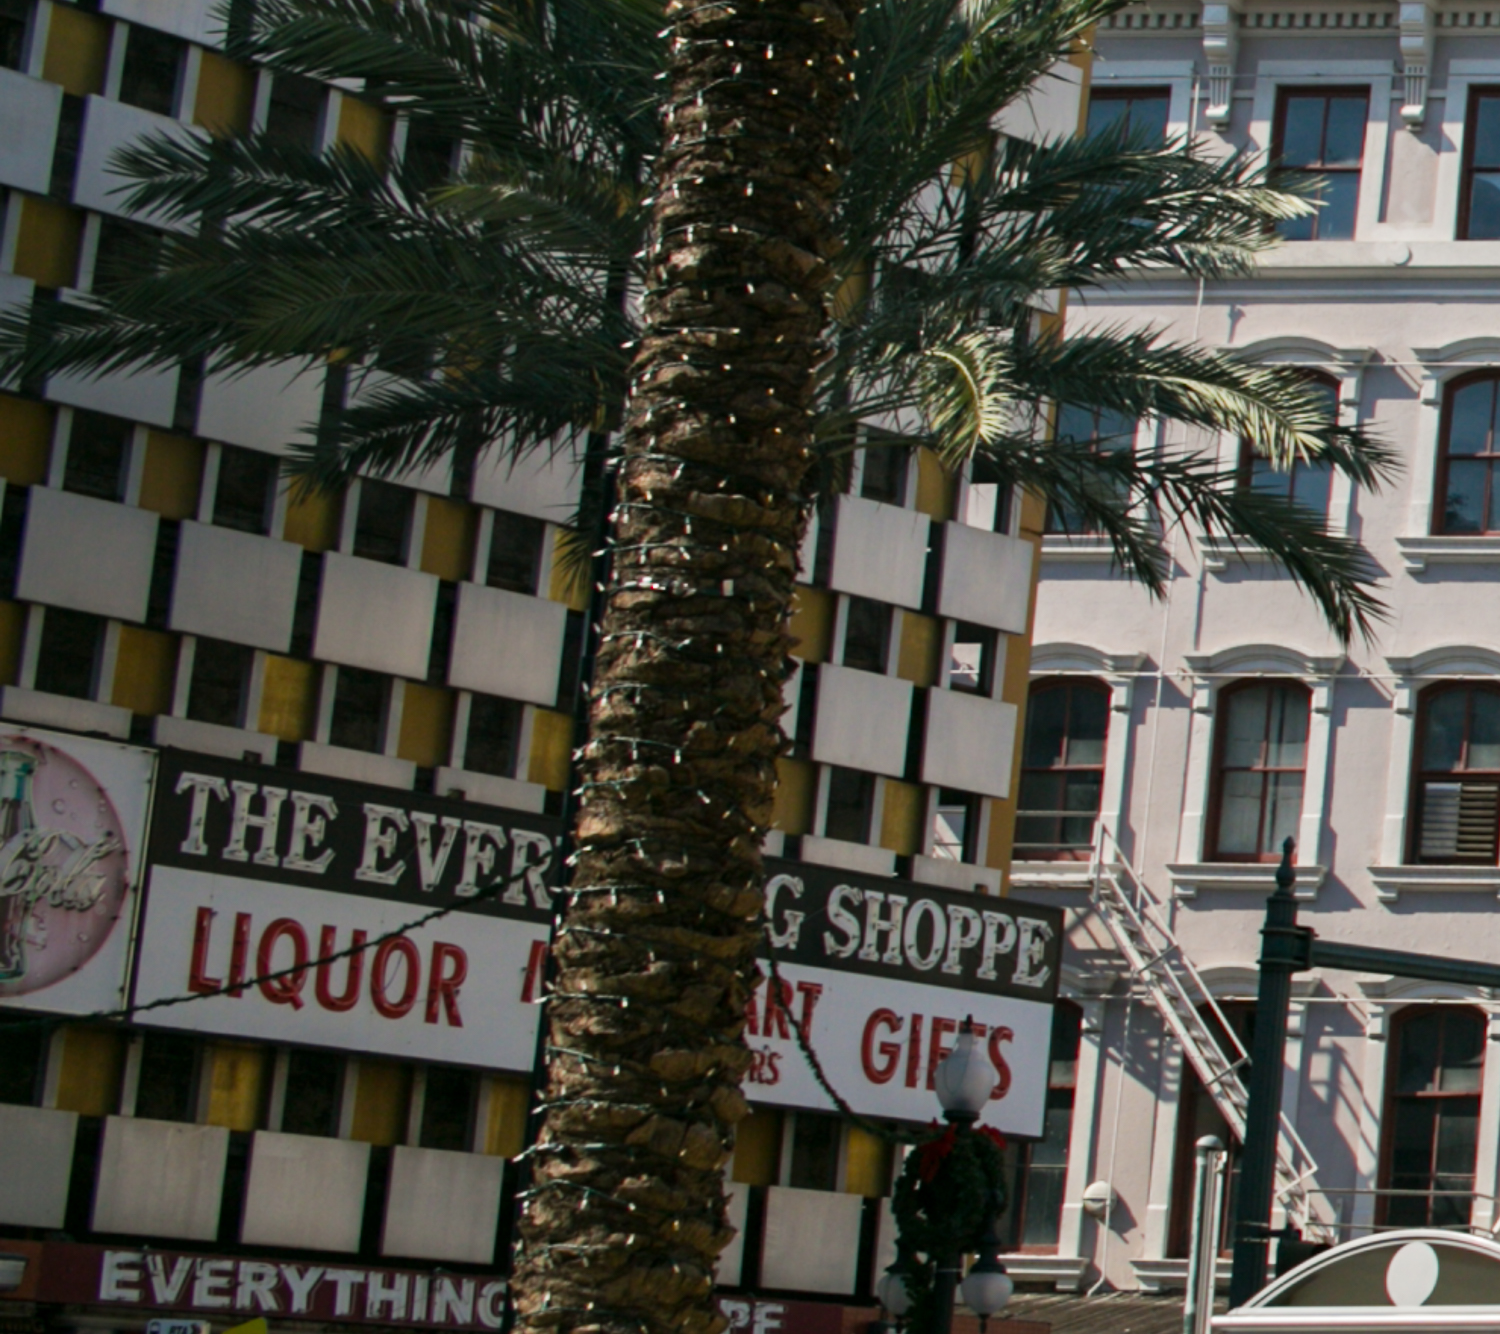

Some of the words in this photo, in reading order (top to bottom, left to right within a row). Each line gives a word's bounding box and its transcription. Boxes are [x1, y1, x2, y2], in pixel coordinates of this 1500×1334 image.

[175, 771, 339, 874] THE
[824, 884, 1054, 988] SHOPPE
[188, 906, 468, 1028] LIQUOR
[861, 1008, 1013, 1101] GIFS
[99, 1250, 507, 1328] EVERYTHING
